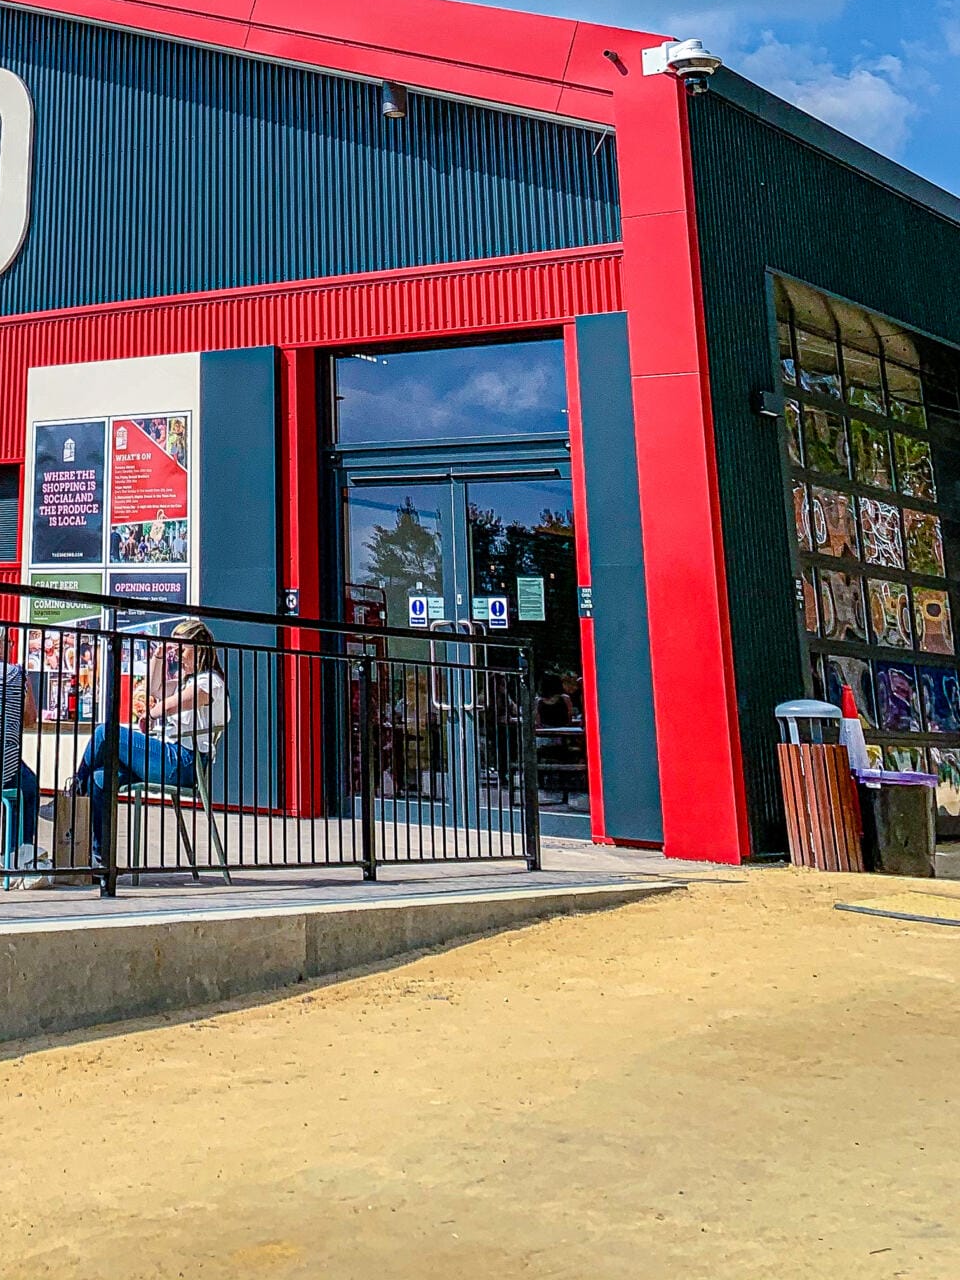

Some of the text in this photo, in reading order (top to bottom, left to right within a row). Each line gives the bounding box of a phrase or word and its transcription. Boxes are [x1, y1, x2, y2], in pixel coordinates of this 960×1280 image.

[115, 452, 152, 461] WHAT'S ON
[44, 470, 95, 481] WHERE THE
[42, 481, 96, 493] SHOPPING IS
[44, 493, 93, 504] SOCIAL AND
[39, 504, 99, 515] THE PRODUCE
[49, 516, 87, 526] IS LOCAL
[59, 580, 79, 590] BEER
[115, 582, 181, 592] OPENING HOURS
[34, 600, 65, 609] COMING
